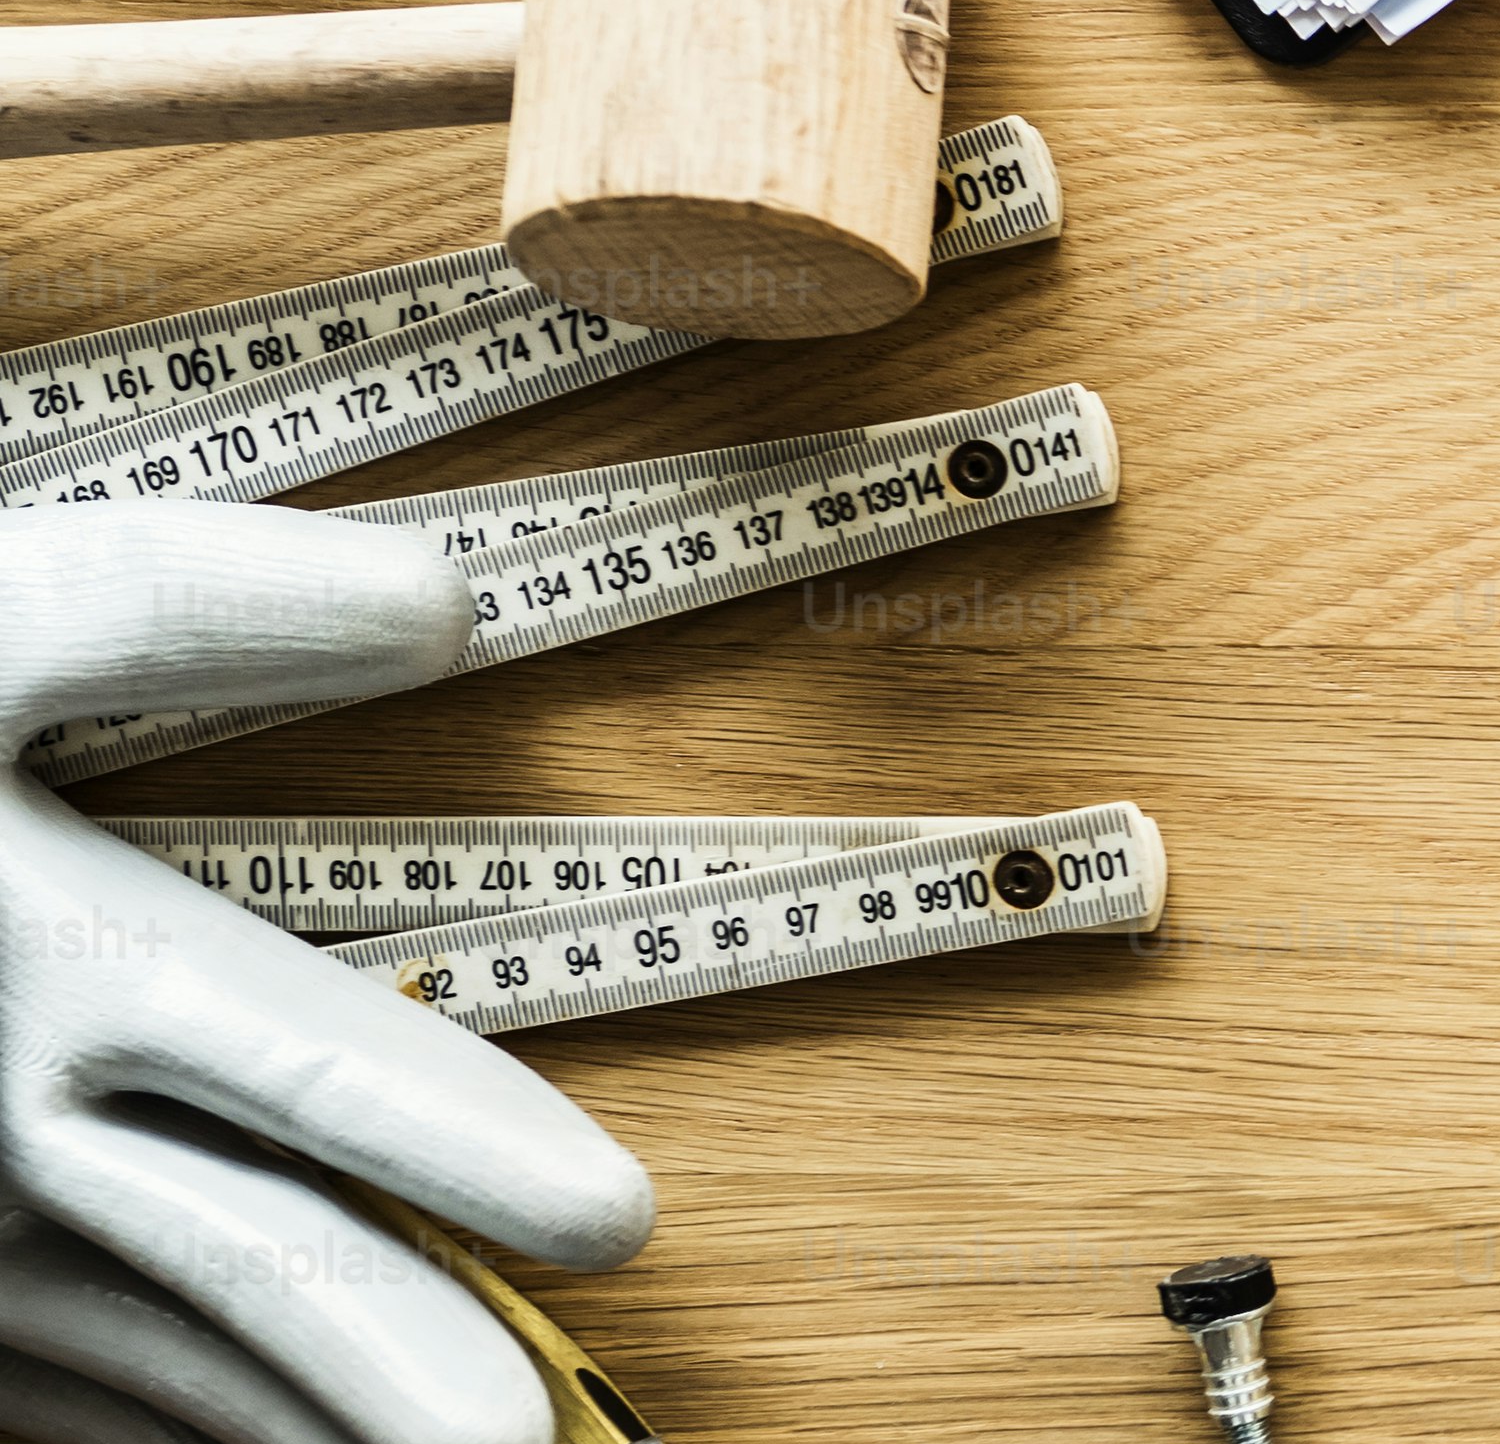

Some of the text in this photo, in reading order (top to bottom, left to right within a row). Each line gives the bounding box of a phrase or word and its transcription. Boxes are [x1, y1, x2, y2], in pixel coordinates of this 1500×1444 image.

[28, 333, 301, 419] 189 190 191 192
[127, 455, 180, 495] 169
[190, 425, 258, 477] 170
[336, 382, 393, 424] 172
[406, 358, 461, 398] 173
[539, 307, 609, 356] 175
[517, 571, 571, 610] 134
[582, 545, 652, 596] 135
[734, 509, 784, 550] 137
[806, 491, 857, 530] 138
[249, 855, 314, 894] 110
[404, 859, 458, 891] 108
[554, 859, 606, 891] 106
[420, 968, 457, 1002] 92
[565, 943, 602, 976] 94
[634, 925, 681, 969] 95
[785, 903, 820, 938] 97
